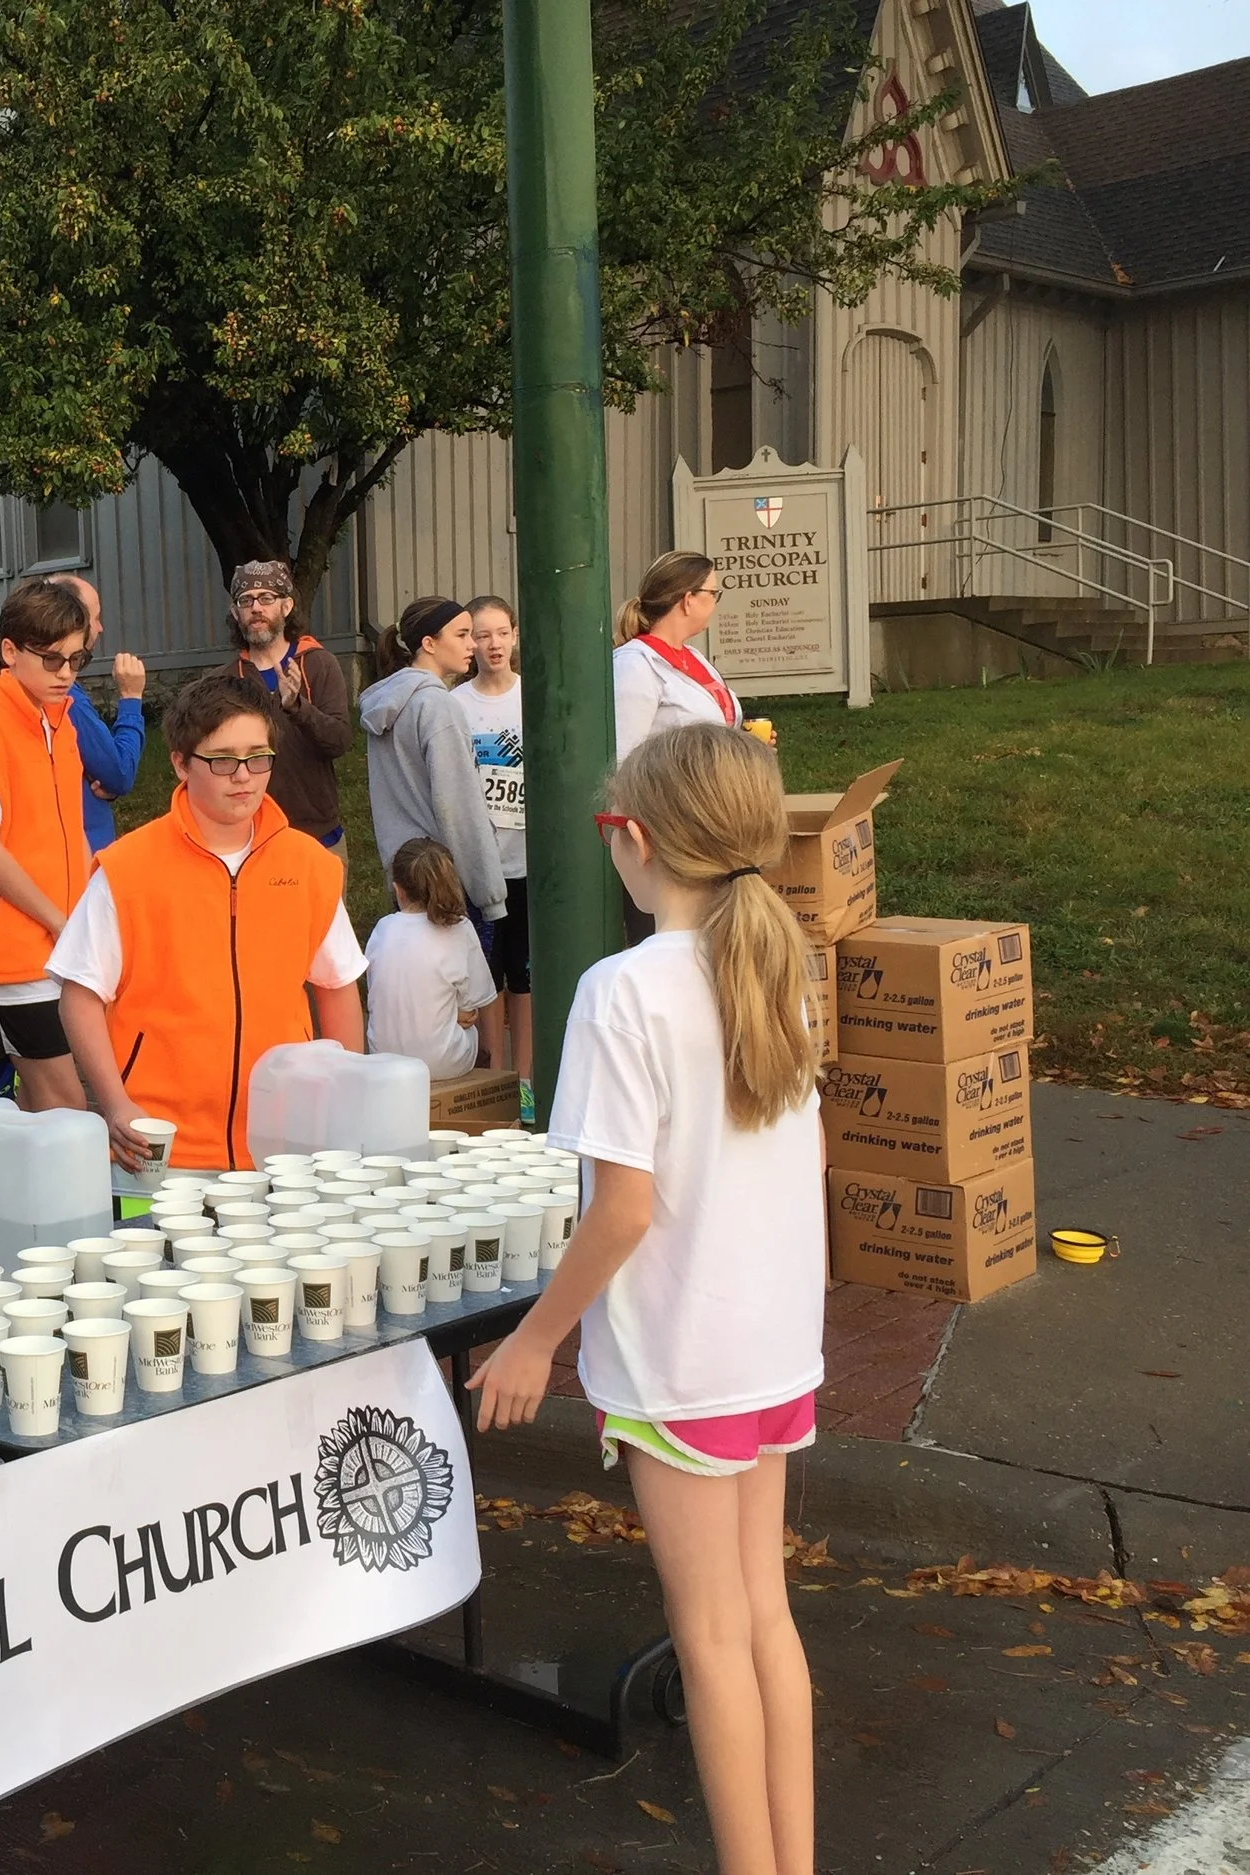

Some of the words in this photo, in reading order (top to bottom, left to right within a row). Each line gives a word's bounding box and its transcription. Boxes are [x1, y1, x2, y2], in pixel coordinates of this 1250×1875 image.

[721, 531, 817, 552] TRINITY
[713, 551, 826, 571] EPISCOPAL
[721, 570, 818, 589] CHURCH
[750, 598, 790, 608] SUNDAY
[786, 885, 816, 895] gallon
[796, 912, 819, 922] ter
[837, 955, 877, 970] rystal
[952, 947, 986, 968] Crystal
[837, 970, 860, 982] ear
[950, 966, 978, 984] Clear
[883, 993, 906, 1003] 2-2.5
[907, 995, 935, 1006] gallon
[965, 1004, 1000, 1021] drinking
[1001, 997, 1025, 1011] water
[840, 1014, 893, 1032] drinking
[897, 1021, 938, 1035] water
[827, 1067, 882, 1087] Crystal
[957, 1066, 989, 1089] Crystal
[823, 1081, 864, 1100] Clear
[956, 1086, 981, 1104] Clear
[886, 1111, 910, 1122] 2-2.5
[911, 1115, 940, 1127] gallon
[969, 1123, 1001, 1141] drinking
[1003, 1115, 1024, 1129] water
[842, 1130, 897, 1151] drinking
[901, 1140, 942, 1154] water
[845, 1182, 897, 1201] Crystal
[840, 1196, 879, 1214] Clear
[901, 1225, 923, 1236] 2-2.5
[925, 1229, 952, 1240] gallon
[859, 1242, 911, 1261] drinking
[915, 1252, 955, 1266] water
[432, 1273, 463, 1281] MidWes
[476, 1268, 498, 1278] Bank
[898, 1271, 909, 1279] do
[912, 1274, 927, 1282] not
[930, 1277, 956, 1287] stack
[904, 1281, 924, 1290] over
[935, 1284, 956, 1295] high
[306, 1316, 330, 1326] Bank
[254, 1332, 278, 1342] Bank
[155, 1367, 179, 1376] Bank
[73, 1381, 111, 1391] estOne
[59, 1472, 311, 1624] CHURCH
